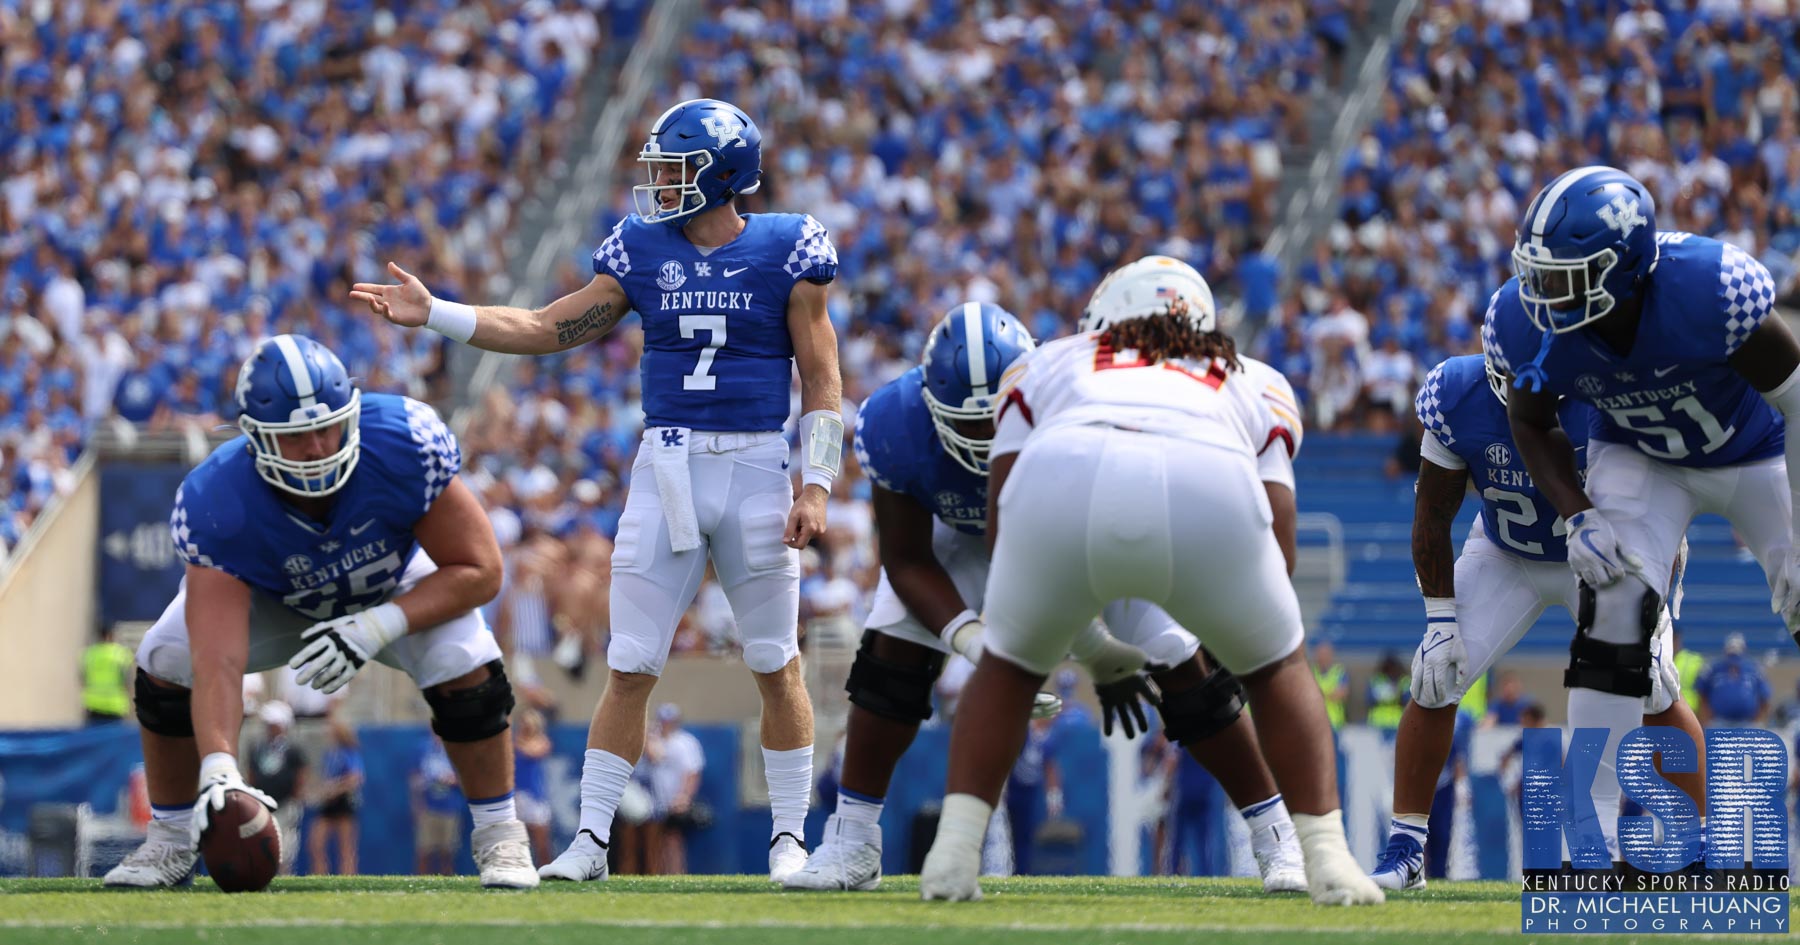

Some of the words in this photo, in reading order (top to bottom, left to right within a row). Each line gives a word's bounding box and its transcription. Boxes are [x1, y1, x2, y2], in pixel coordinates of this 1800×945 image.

[701, 116, 747, 149] UK
[1596, 195, 1648, 240] UK
[661, 262, 682, 284] SEC
[694, 261, 712, 277] UK
[660, 291, 753, 311] KENTUCKY
[678, 315, 728, 391] 7
[1577, 375, 1603, 394] SEC
[1593, 380, 1697, 410] KENTUCKY
[661, 428, 684, 447] UK
[1606, 395, 1736, 460] 51
[1487, 444, 1511, 466] SEC
[284, 556, 311, 574] SEC
[290, 539, 388, 590] KENTUCKY
